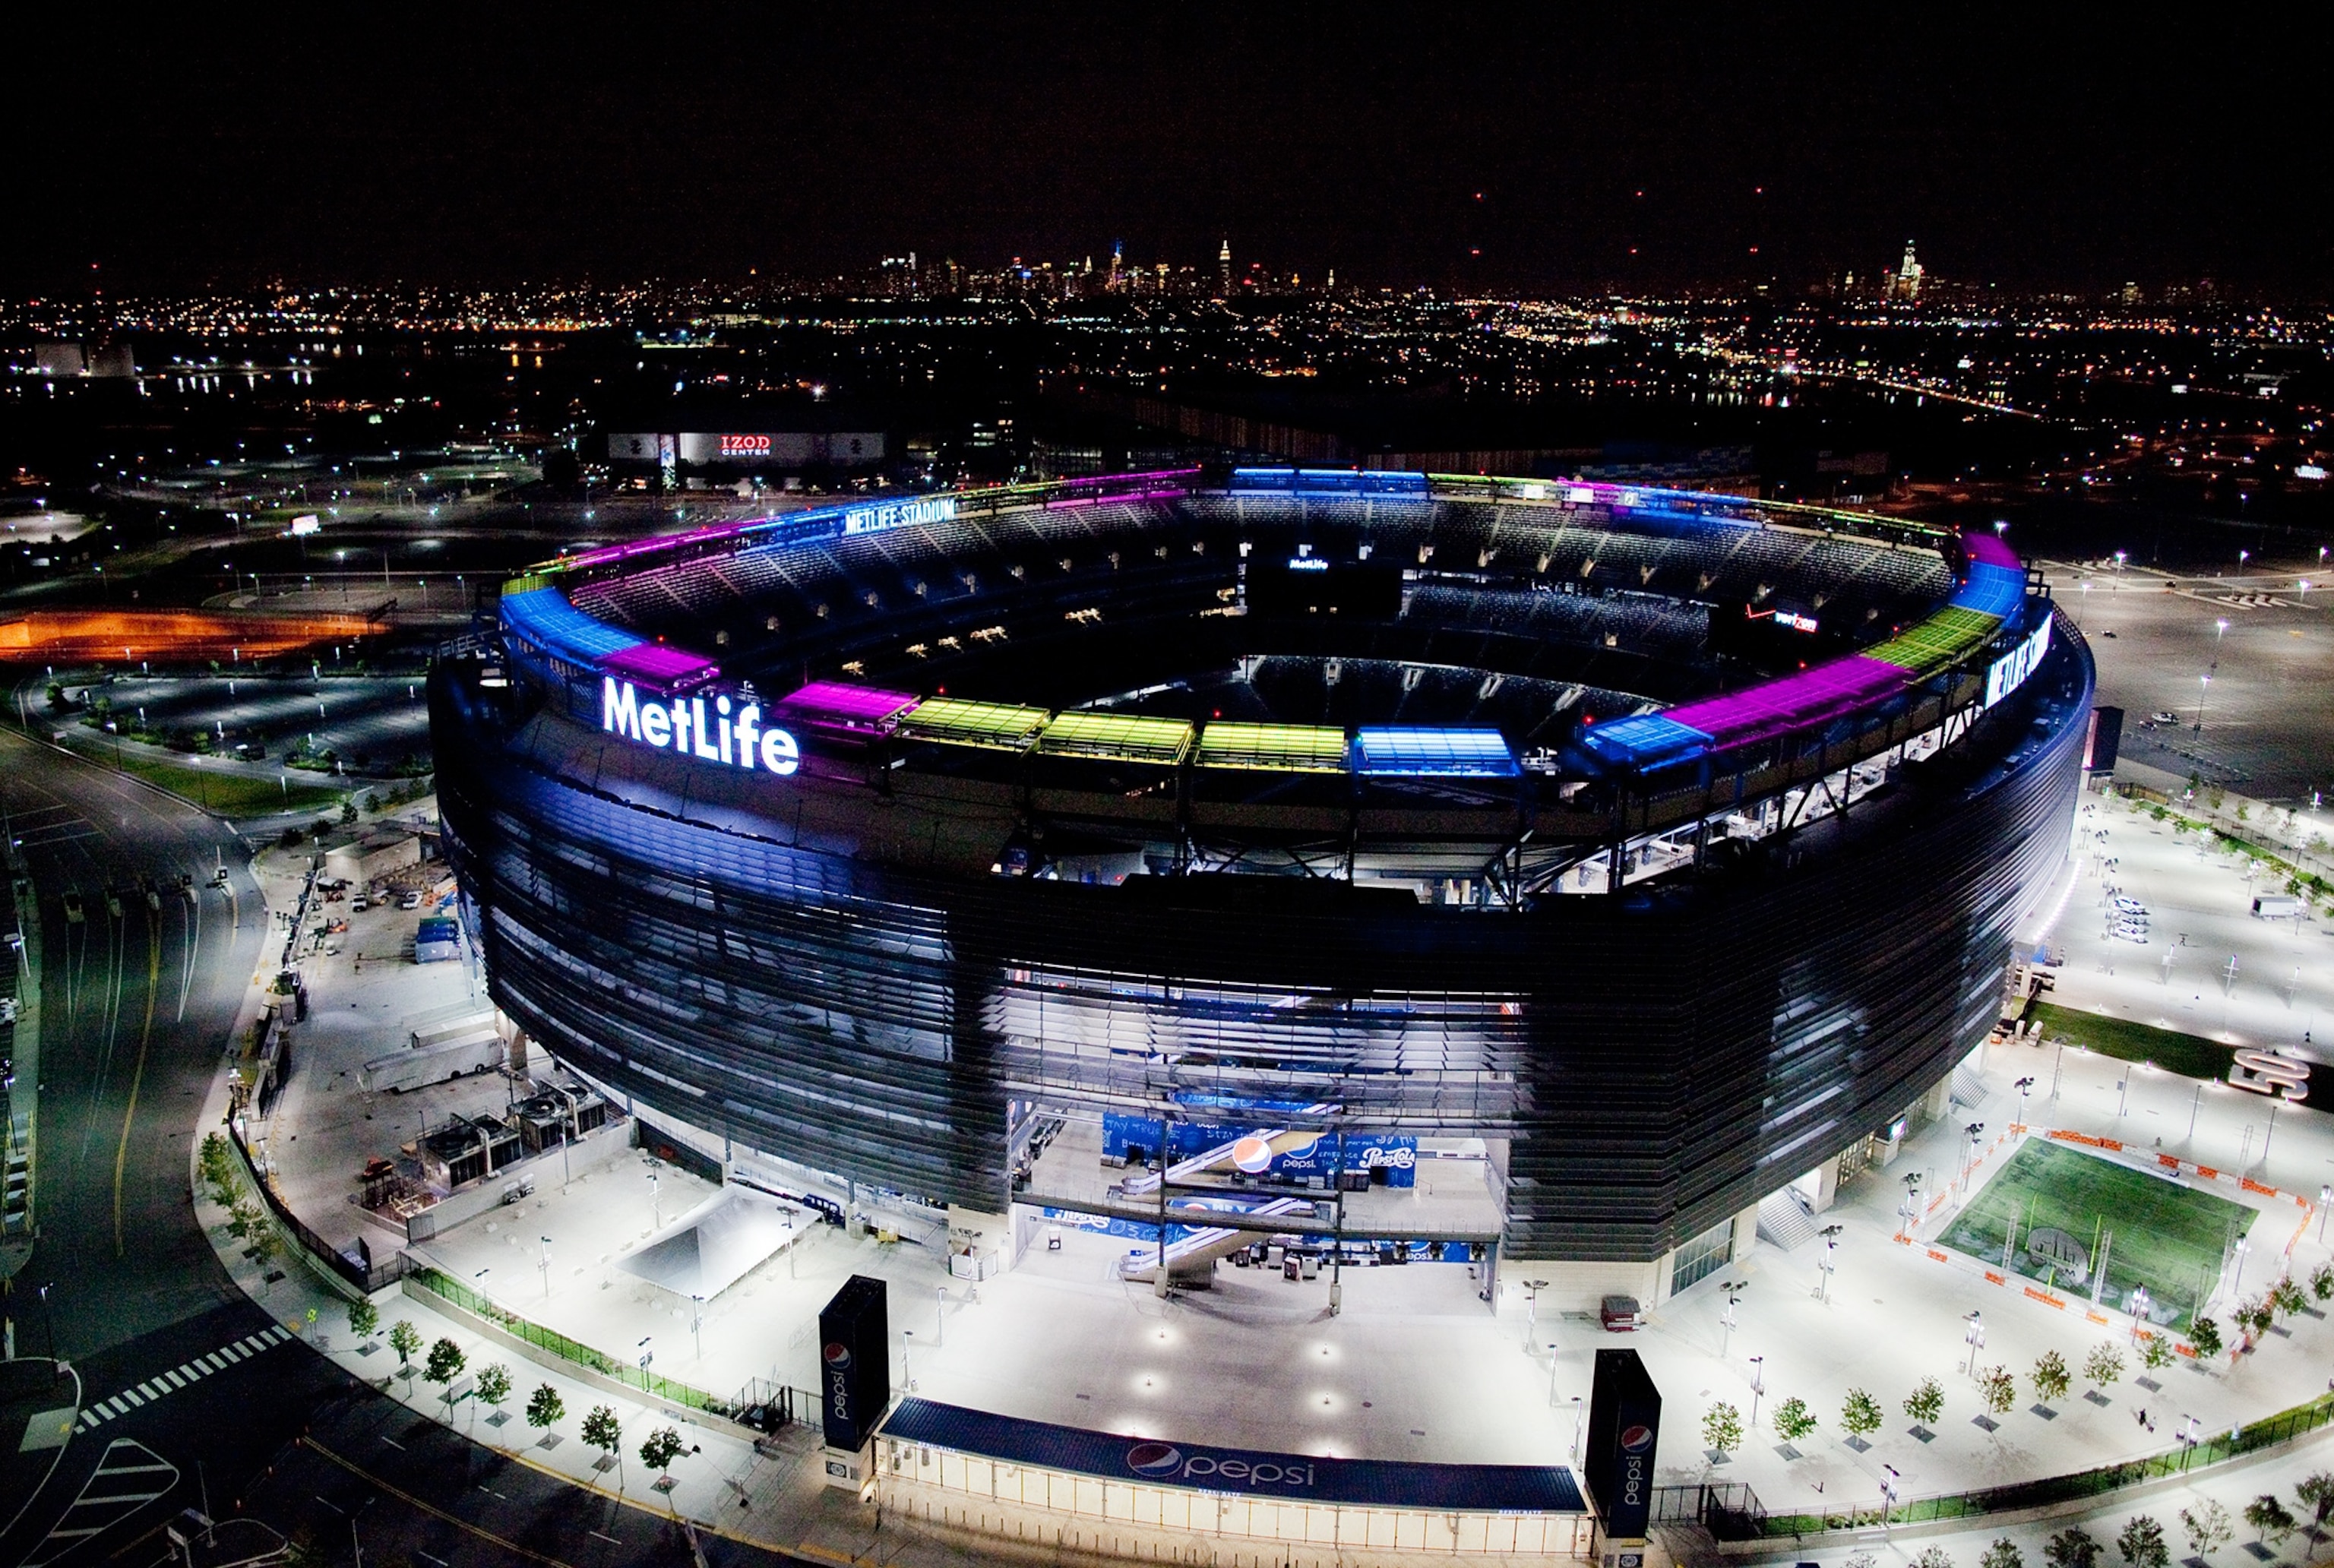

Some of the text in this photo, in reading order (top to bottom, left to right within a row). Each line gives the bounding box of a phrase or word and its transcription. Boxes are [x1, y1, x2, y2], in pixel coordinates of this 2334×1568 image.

[720, 435, 770, 448] IZOD
[845, 498, 955, 536] METLIFE STADIUM
[604, 675, 799, 776] MetLife
[830, 1370, 849, 1419] pepsi
[1184, 1456, 1314, 1486] pepsi
[1624, 1456, 1643, 1505] pepsi
